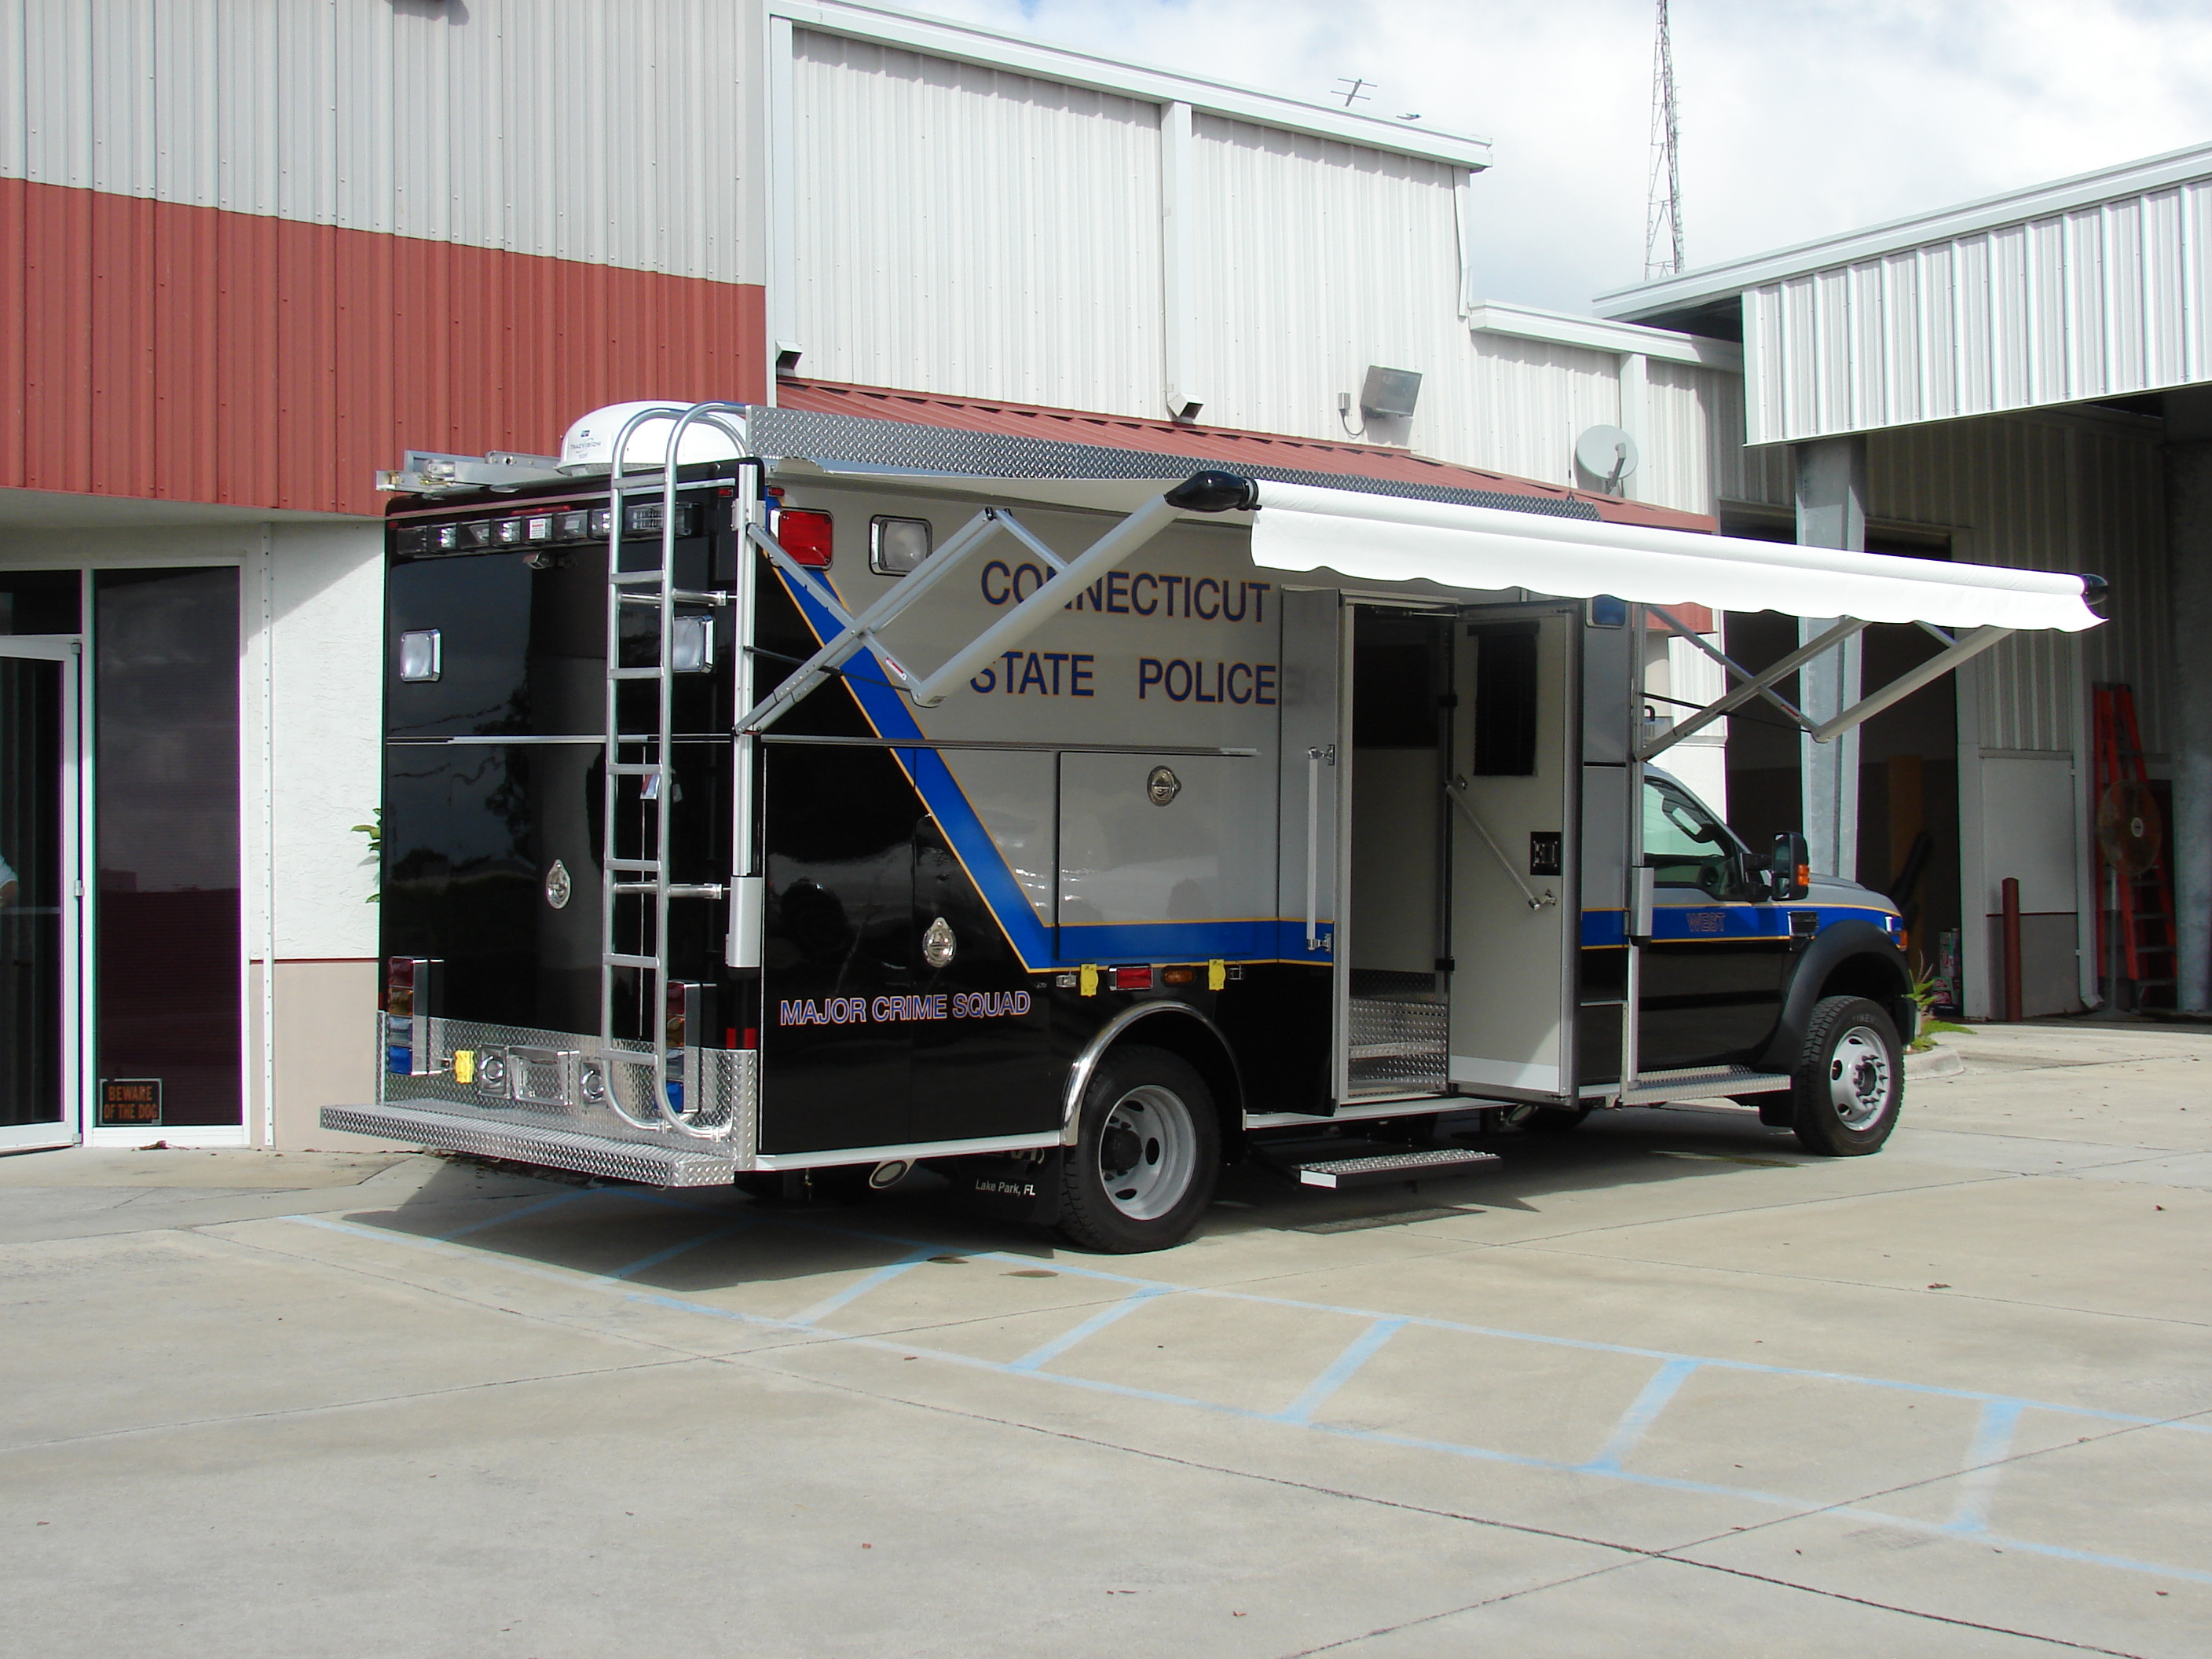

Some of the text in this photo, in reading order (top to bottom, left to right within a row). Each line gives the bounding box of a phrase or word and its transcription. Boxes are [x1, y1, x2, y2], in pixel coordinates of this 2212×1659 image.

[1138, 657, 1276, 705] POLICE
[1686, 912, 1726, 932] WEST
[781, 991, 1031, 1026] MAJOR CRIME SQUAD
[108, 1086, 152, 1101] BEWARE
[103, 1104, 157, 1119] OF THE DOG
[976, 1179, 1036, 1196] Lake Park, FL
